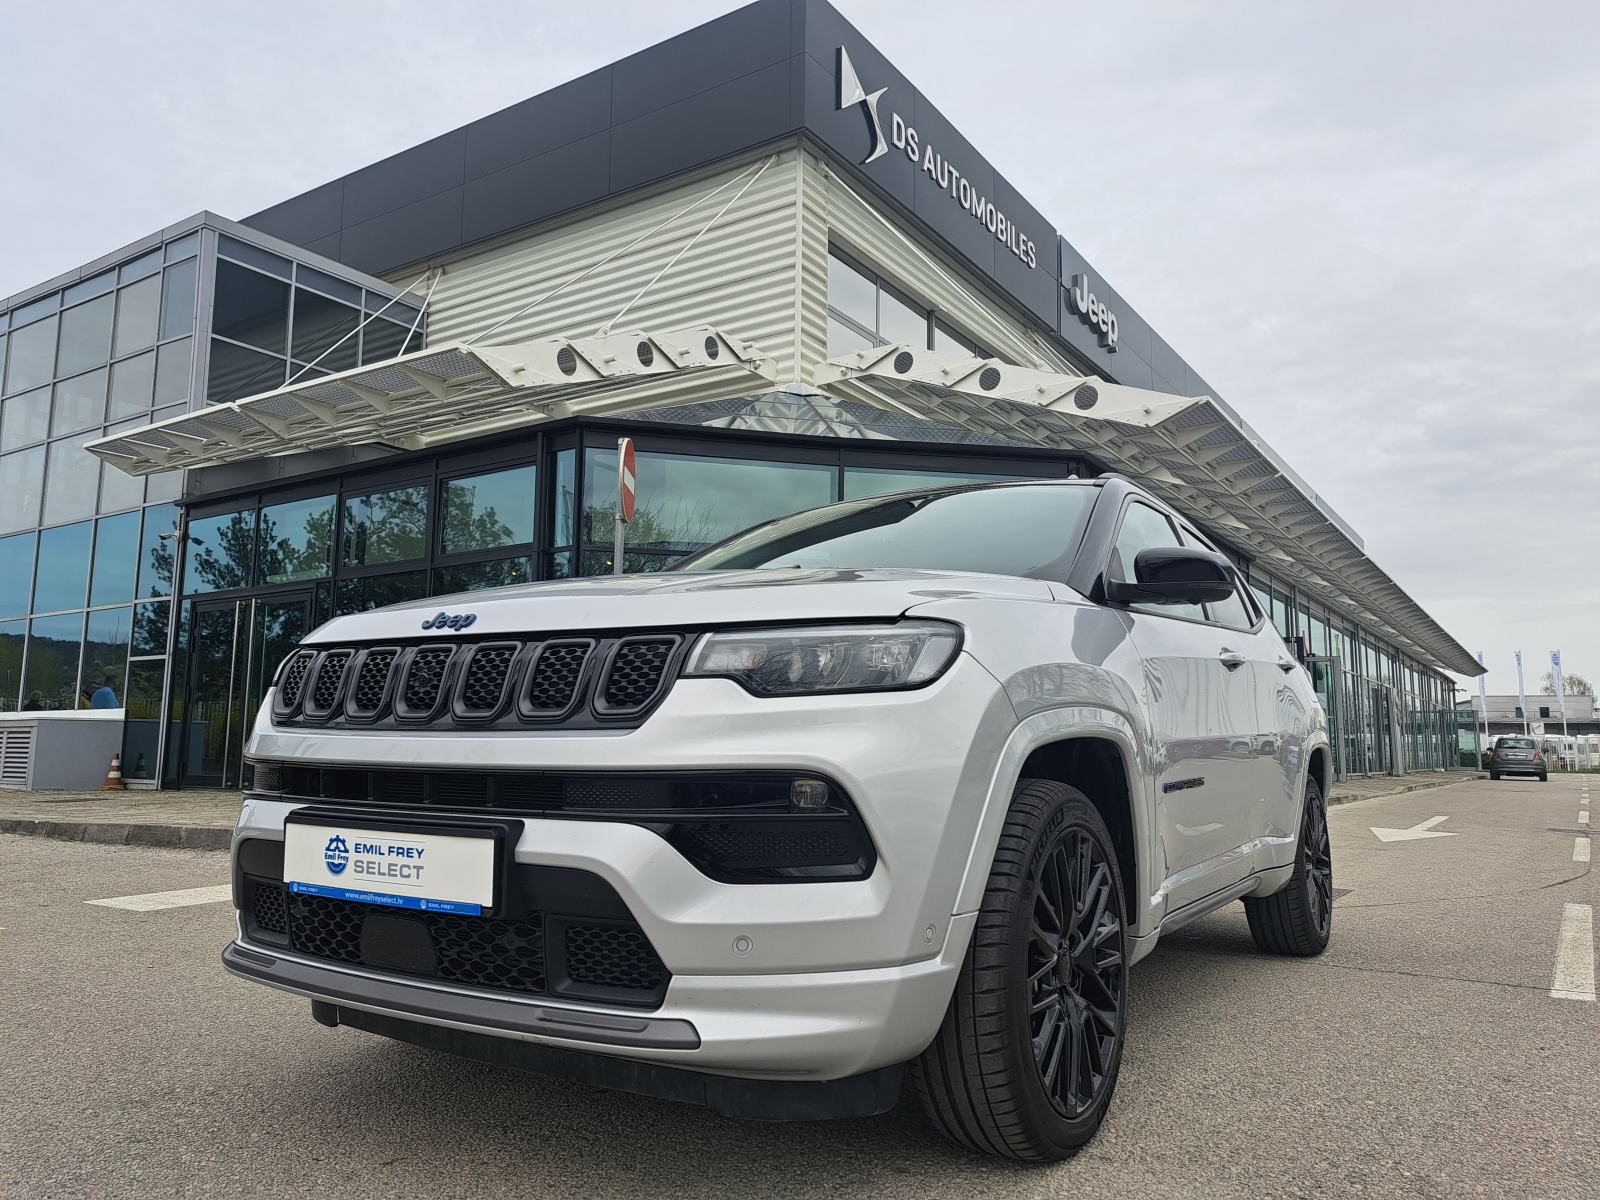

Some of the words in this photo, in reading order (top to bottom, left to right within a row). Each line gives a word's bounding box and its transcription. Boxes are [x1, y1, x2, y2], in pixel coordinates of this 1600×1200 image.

[891, 112, 919, 162] DS
[921, 144, 1036, 269] AUTOMOBILES
[1071, 273, 1118, 350] Jeep
[421, 612, 477, 631] Jeep
[324, 852, 337, 861] Emil
[337, 854, 349, 863] Frey
[354, 843, 385, 856] EMIL
[388, 846, 425, 859] FREY
[353, 860, 424, 879] SELECT
